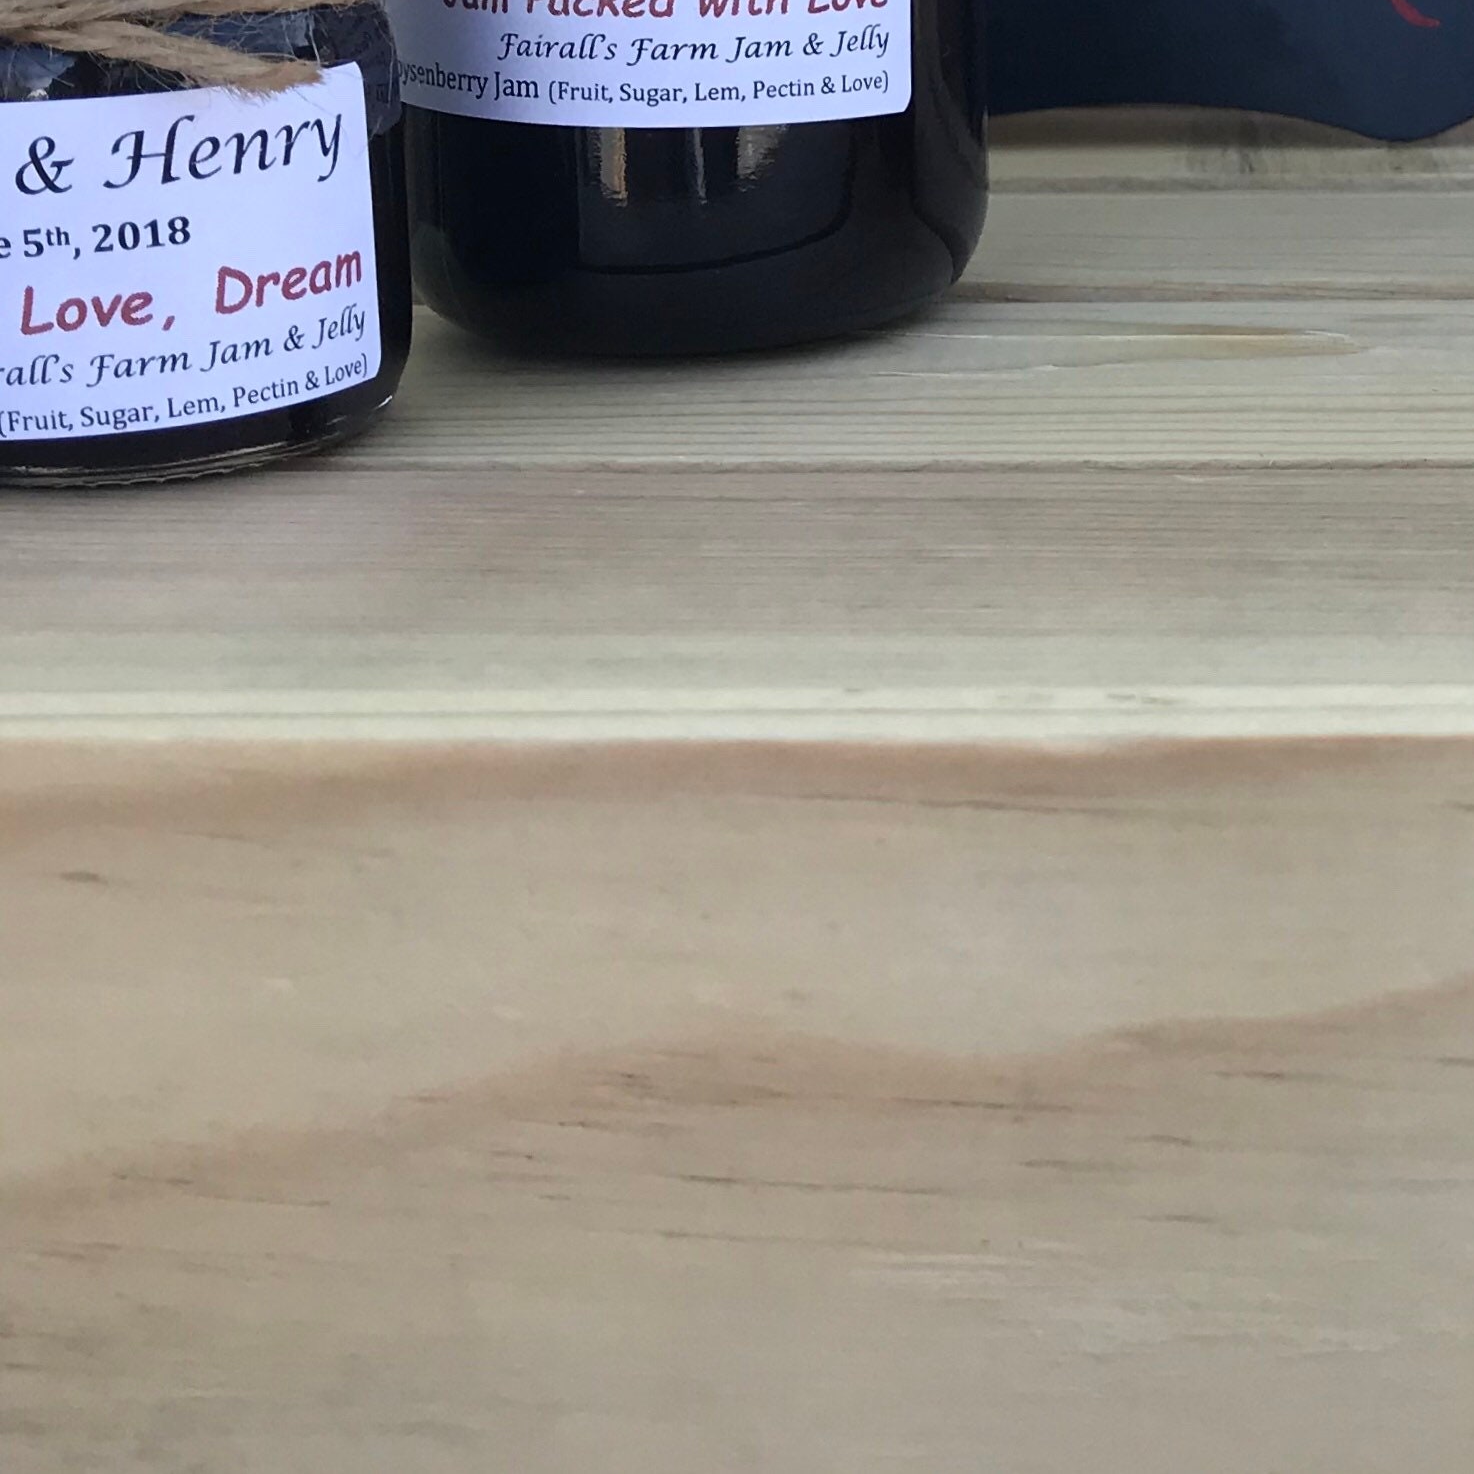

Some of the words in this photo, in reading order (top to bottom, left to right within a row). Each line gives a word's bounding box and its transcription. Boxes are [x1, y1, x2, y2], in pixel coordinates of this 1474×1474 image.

[498, 32, 618, 62] Fairall's
[625, 37, 719, 67] Farm
[724, 36, 794, 64] Jam
[802, 32, 824, 56] &
[828, 23, 890, 59] Jelly
[397, 61, 488, 100] ysenberry
[491, 67, 540, 104] Jam
[548, 80, 614, 106] (Fruit,
[619, 82, 688, 108] Sugar,
[694, 82, 746, 103] Lem,
[753, 80, 815, 100] Pectin
[820, 75, 837, 95] &
[841, 69, 889, 94] Love)
[14, 135, 75, 196] &
[102, 113, 342, 190] Henry
[22, 226, 81, 261] 5th,
[91, 215, 191, 253] 2018
[20, 285, 176, 336] Love,
[215, 250, 363, 315] Dream
[0, 353, 74, 386] all's
[85, 352, 192, 388] Farm
[199, 337, 273, 373] Jam
[283, 324, 305, 352] &
[312, 303, 366, 351] Jelly
[80, 406, 160, 431] Sugar,
[168, 397, 226, 419] Lem,
[232, 380, 300, 409] Pectin
[304, 370, 321, 391] &
[324, 353, 368, 385] Love)
